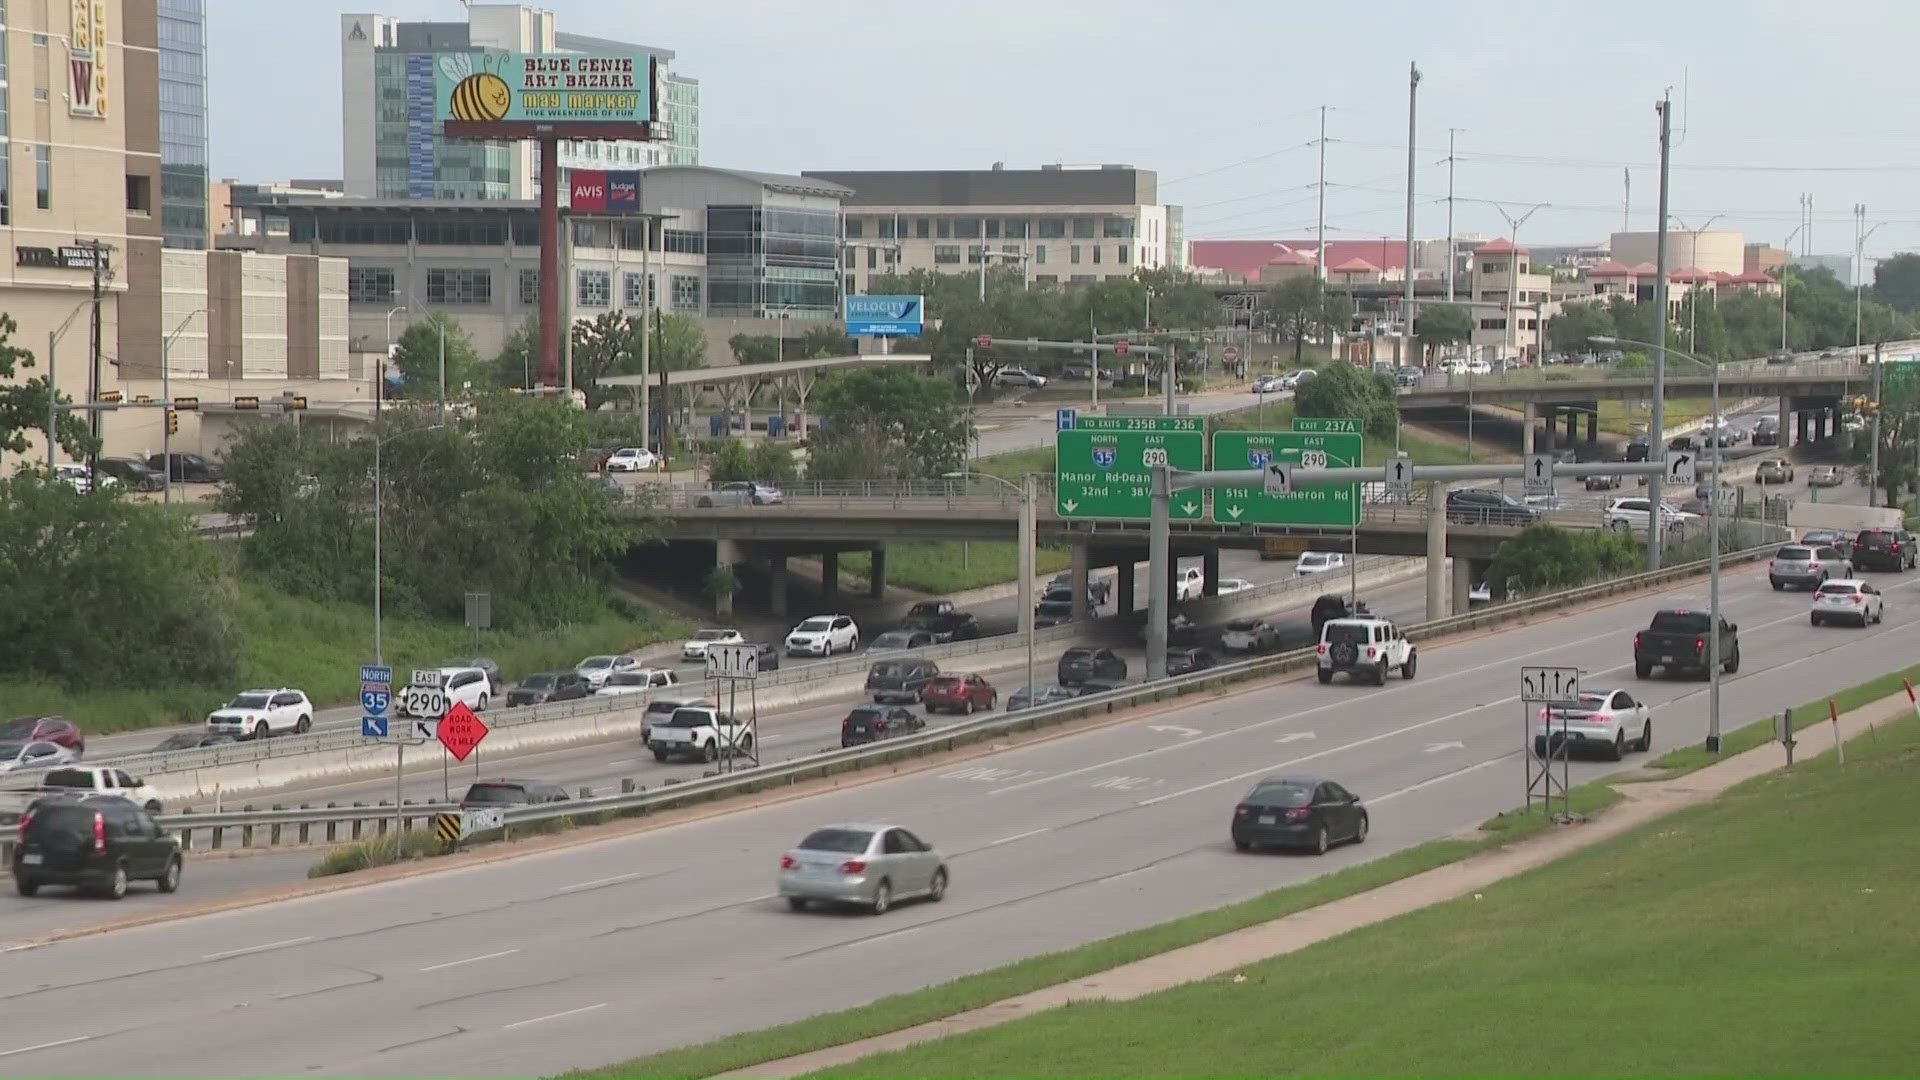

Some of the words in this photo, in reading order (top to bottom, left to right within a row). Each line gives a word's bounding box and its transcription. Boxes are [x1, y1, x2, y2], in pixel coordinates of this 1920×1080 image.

[525, 58, 571, 72] BLUE
[578, 58, 633, 72] GENIE
[71, 60, 93, 105] W
[525, 74, 559, 88] ART
[566, 74, 634, 88] BAZAAR
[574, 185, 603, 198] AVIS
[610, 182, 635, 192] Budget
[849, 301, 905, 312] VELOCITY
[1058, 410, 1075, 429] H
[1084, 419, 1096, 428] TO
[1099, 419, 1121, 428] EXITS
[1127, 419, 1156, 429] 235B
[1174, 419, 1195, 430] 236
[1300, 422, 1318, 430] EXIT
[1325, 421, 1355, 432] 237A
[1090, 435, 1118, 444] NORTH
[1145, 436, 1165, 444] EAST
[1247, 436, 1275, 445] NORTH
[1304, 437, 1325, 446] EAST
[1096, 452, 1113, 464] 35
[1145, 452, 1166, 463] 290
[1304, 453, 1325, 466] 290
[1061, 472, 1097, 482] Manor
[1670, 475, 1691, 483] ONLY
[1081, 486, 1109, 496] 32nd
[1226, 488, 1248, 498] 51st
[1334, 490, 1349, 500] Rd
[1266, 485, 1288, 493] ONLY
[362, 668, 390, 681] NORTH
[415, 672, 437, 684] EAST
[364, 692, 387, 708] 35
[410, 693, 441, 712] 290
[449, 715, 472, 723] ROAD
[449, 725, 472, 734] WORK
[458, 737, 475, 745] MILE
